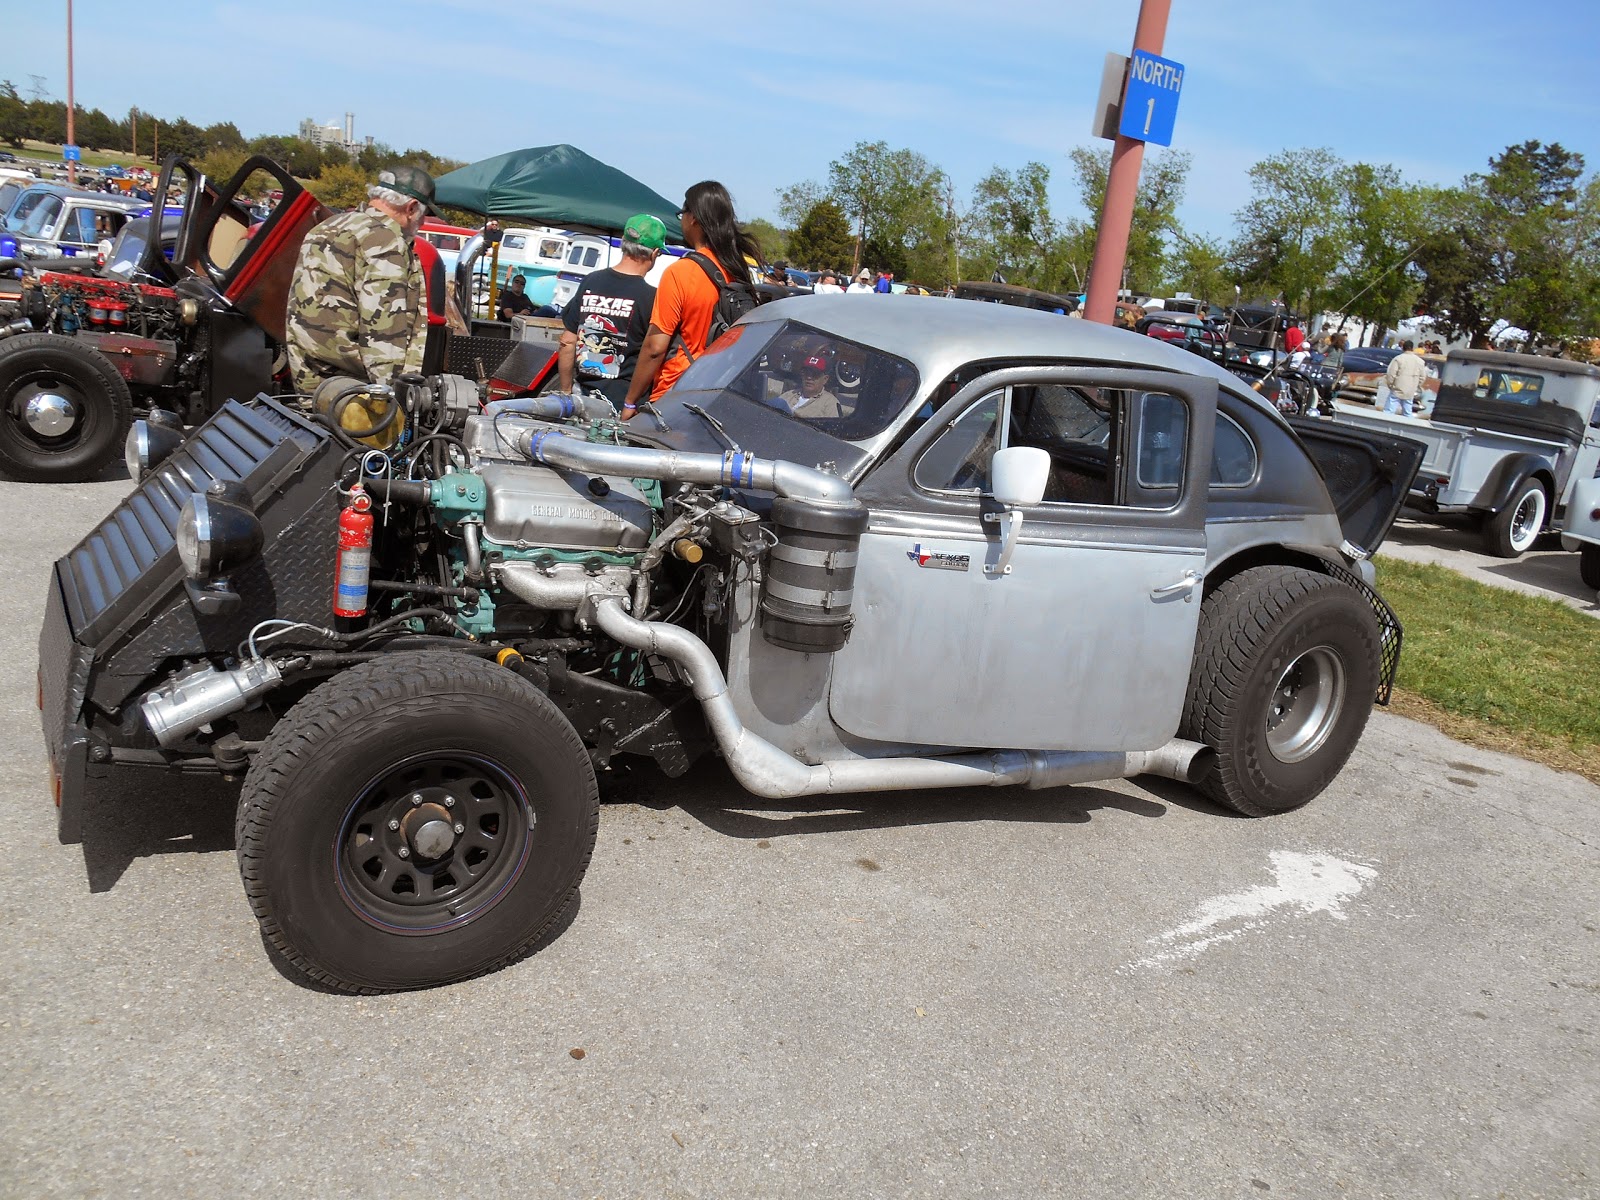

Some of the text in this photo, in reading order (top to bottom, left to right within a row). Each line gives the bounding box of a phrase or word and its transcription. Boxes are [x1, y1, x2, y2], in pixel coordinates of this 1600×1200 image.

[1131, 55, 1183, 93] NORTH
[1143, 97, 1156, 135] 1
[582, 294, 635, 311] TEXAS
[531, 504, 564, 518] GENERAL
[568, 506, 598, 520] MOTORS
[933, 552, 970, 562] TEXAS
